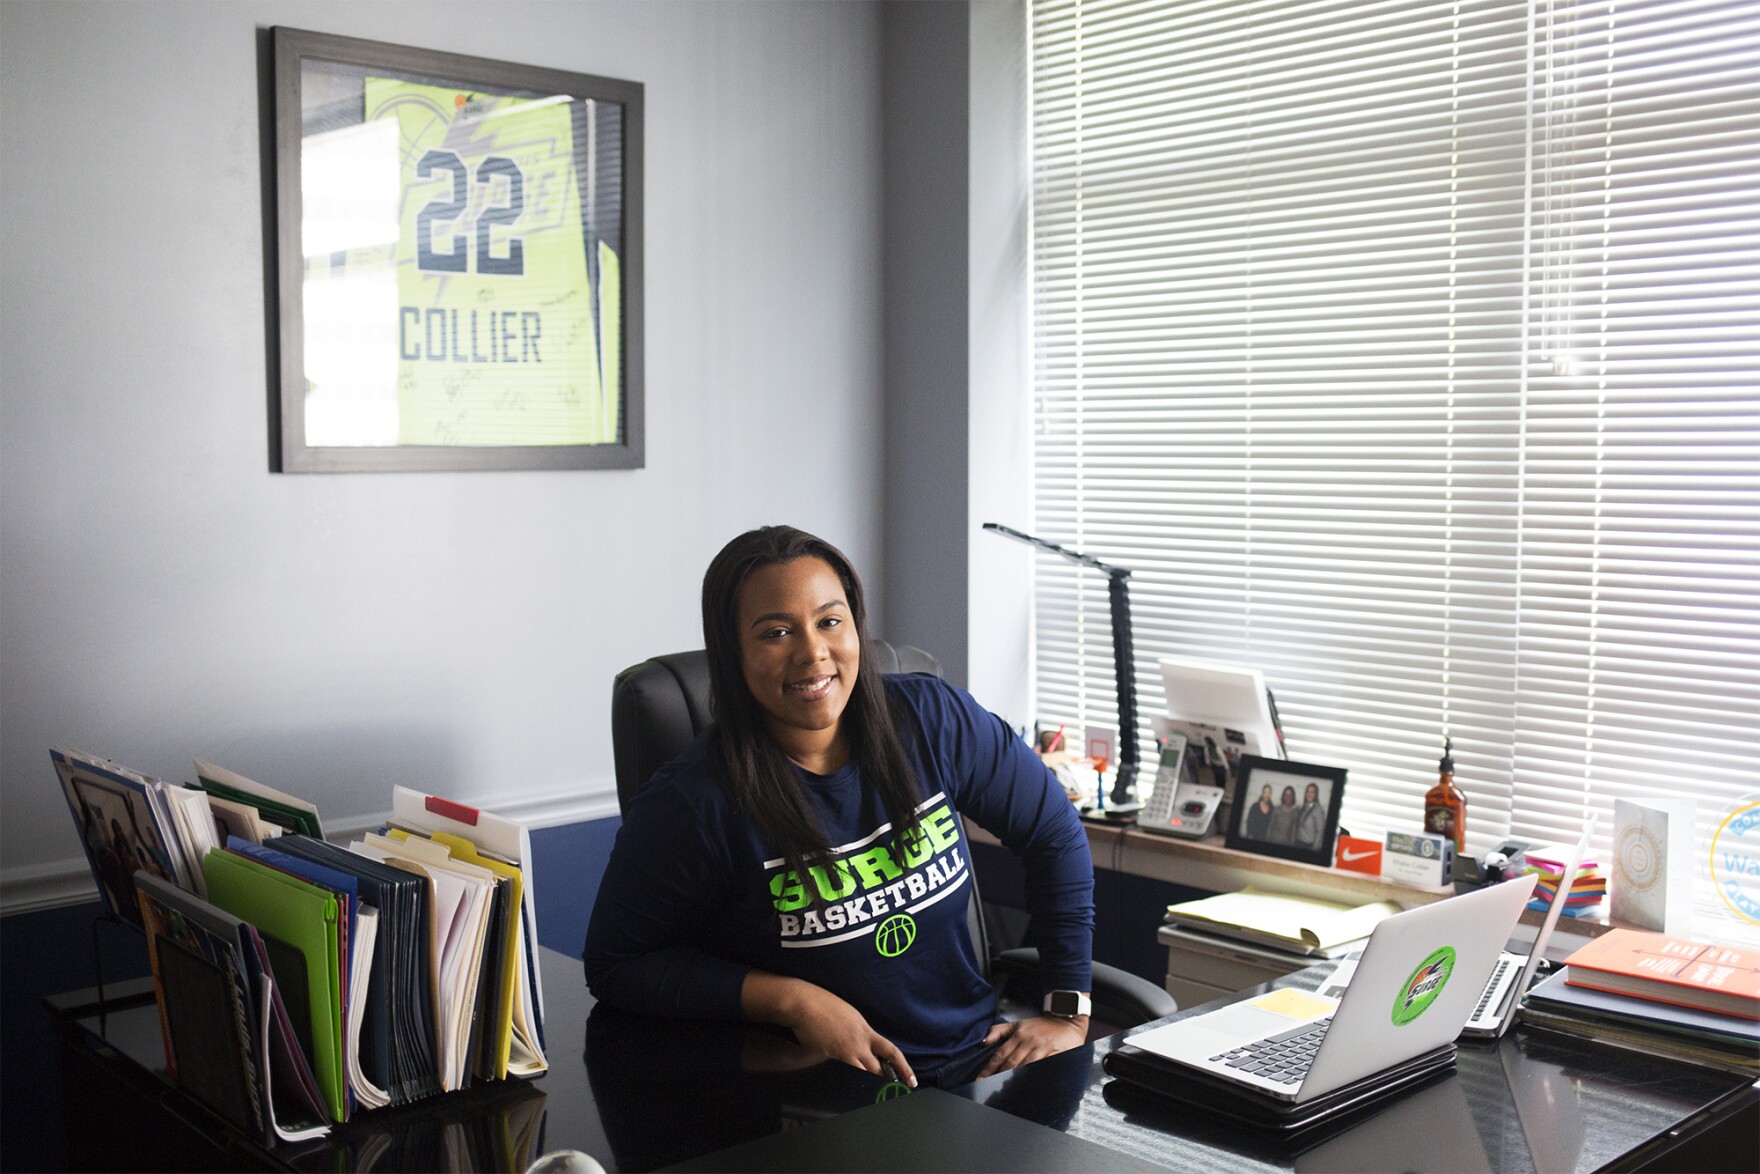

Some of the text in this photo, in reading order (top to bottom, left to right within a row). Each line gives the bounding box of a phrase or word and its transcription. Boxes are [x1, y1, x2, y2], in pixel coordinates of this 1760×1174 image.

[416, 149, 525, 277] 22
[400, 306, 542, 363] COLLIER
[769, 804, 960, 912] SURGE
[780, 848, 966, 937] BASKETBALL
